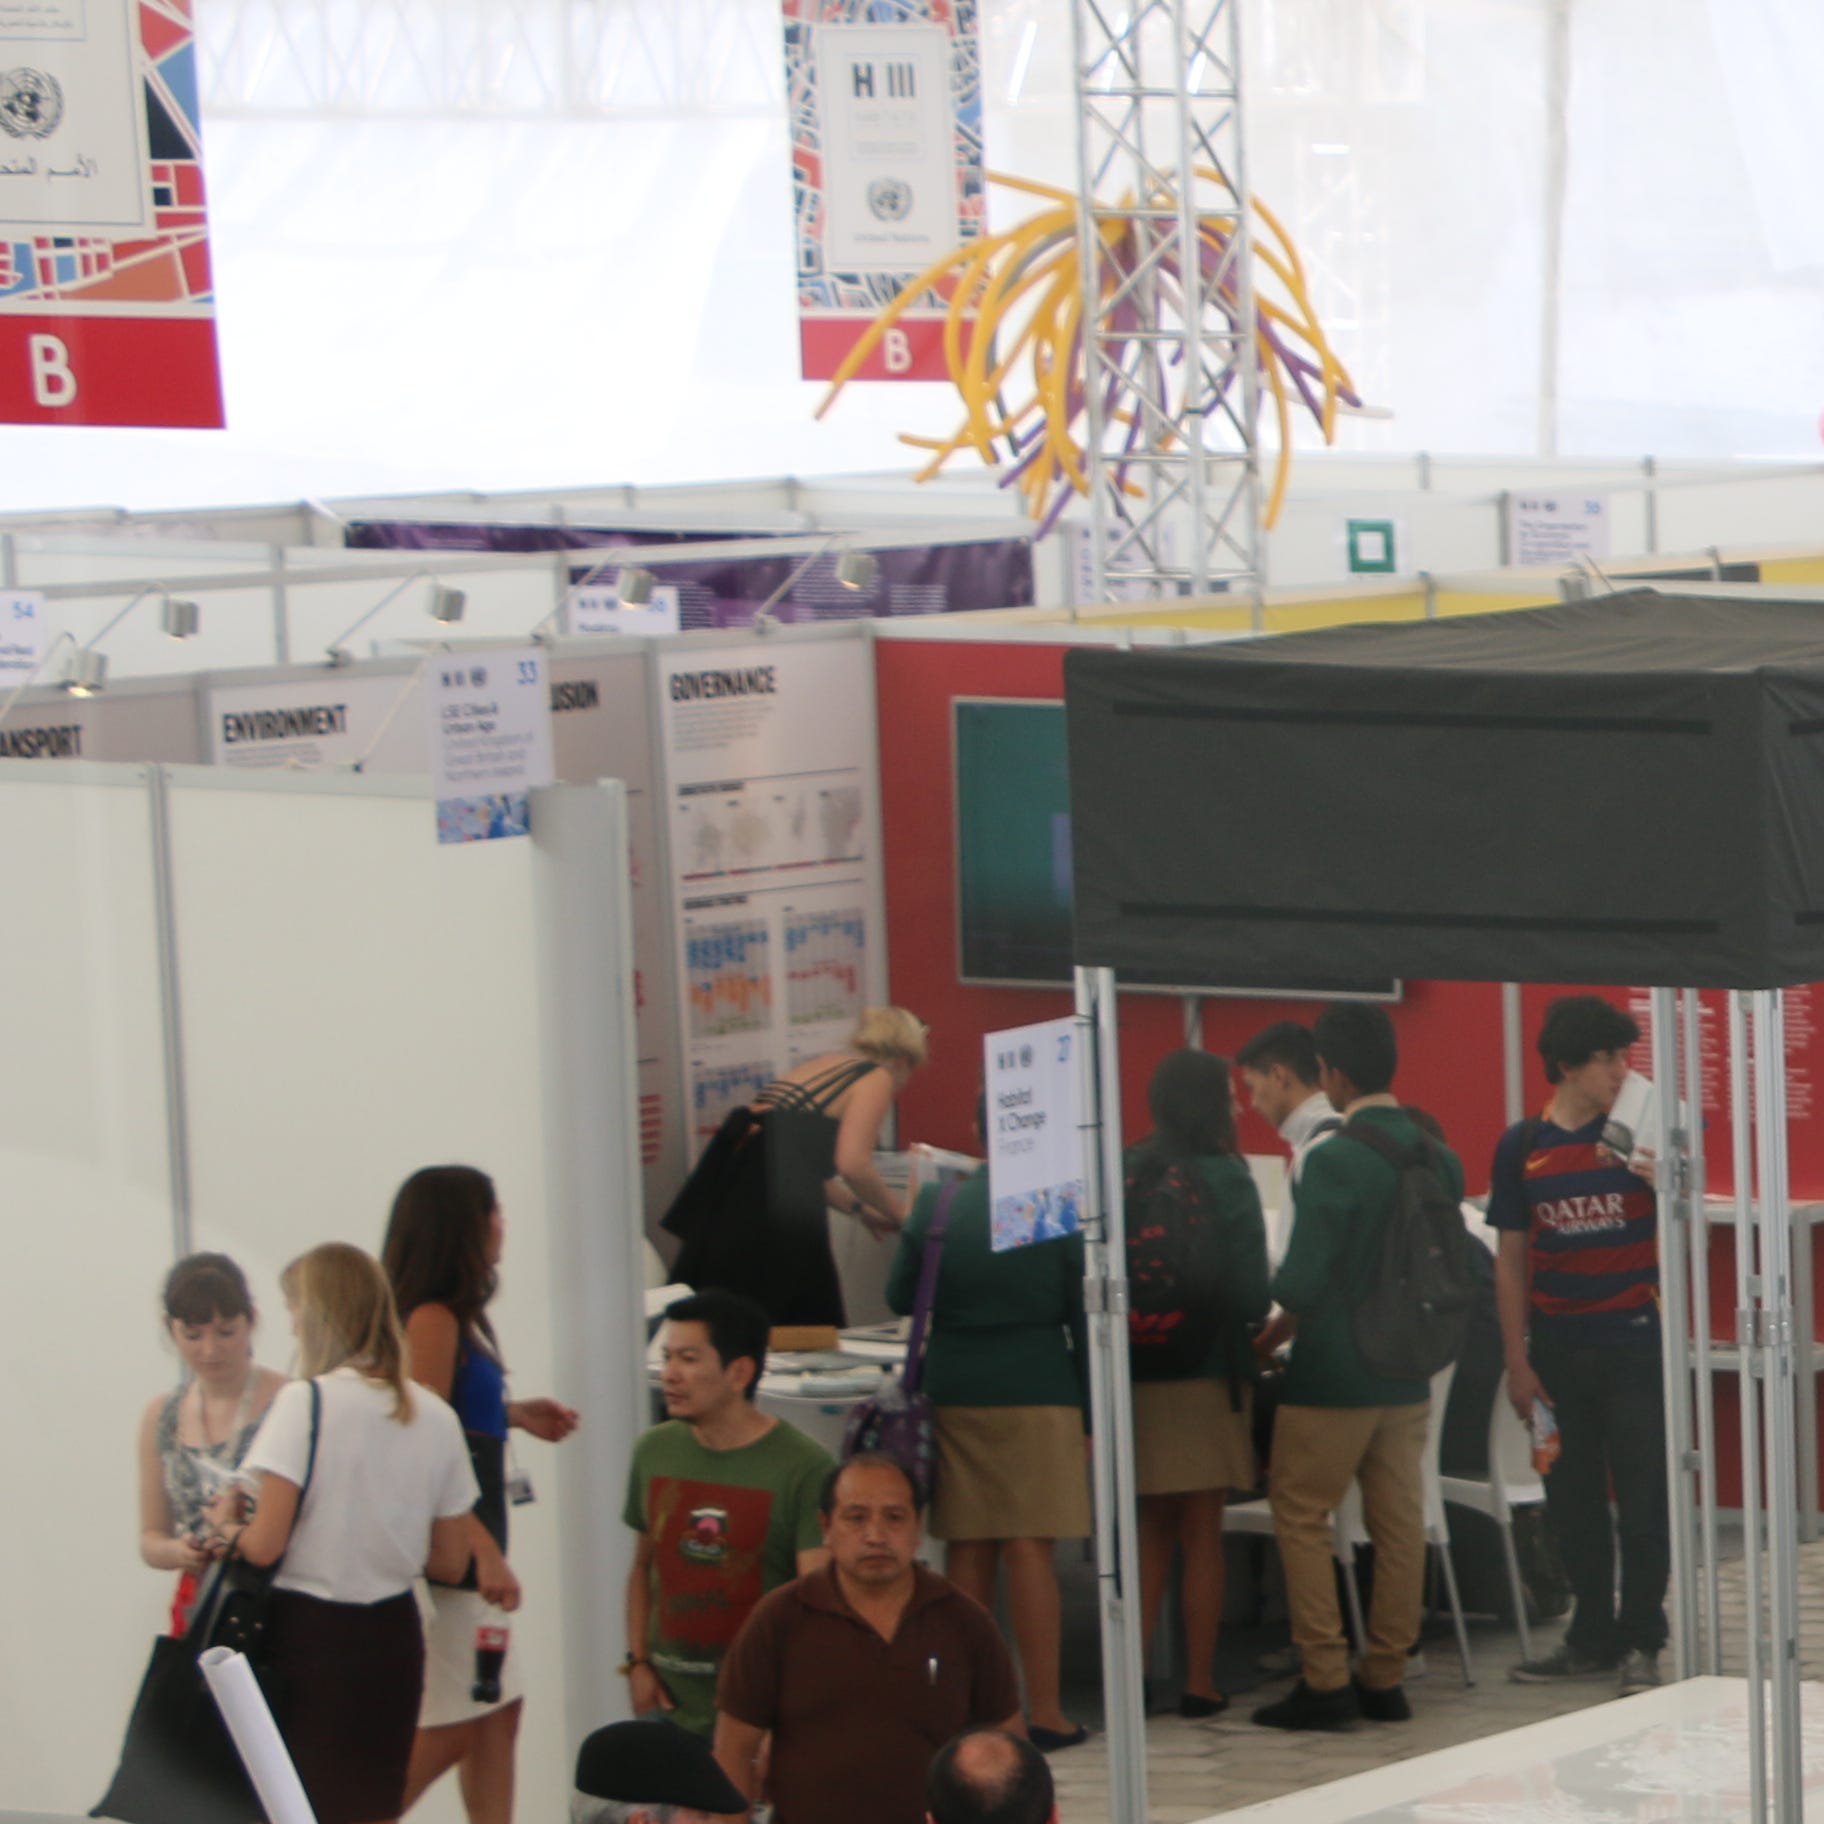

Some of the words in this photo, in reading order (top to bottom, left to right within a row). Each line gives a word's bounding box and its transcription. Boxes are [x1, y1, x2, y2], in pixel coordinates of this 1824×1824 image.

[853, 63, 873, 97] H
[887, 63, 914, 97] III
[884, 328, 912, 373] B
[29, 333, 77, 407] B
[518, 661, 537, 684] 33
[670, 665, 776, 702] GOVERNANCE
[224, 704, 346, 743] ENVIRONMENT
[1537, 1193, 1625, 1226] QATAR
[1557, 1216, 1626, 1236] AIRWAYS
